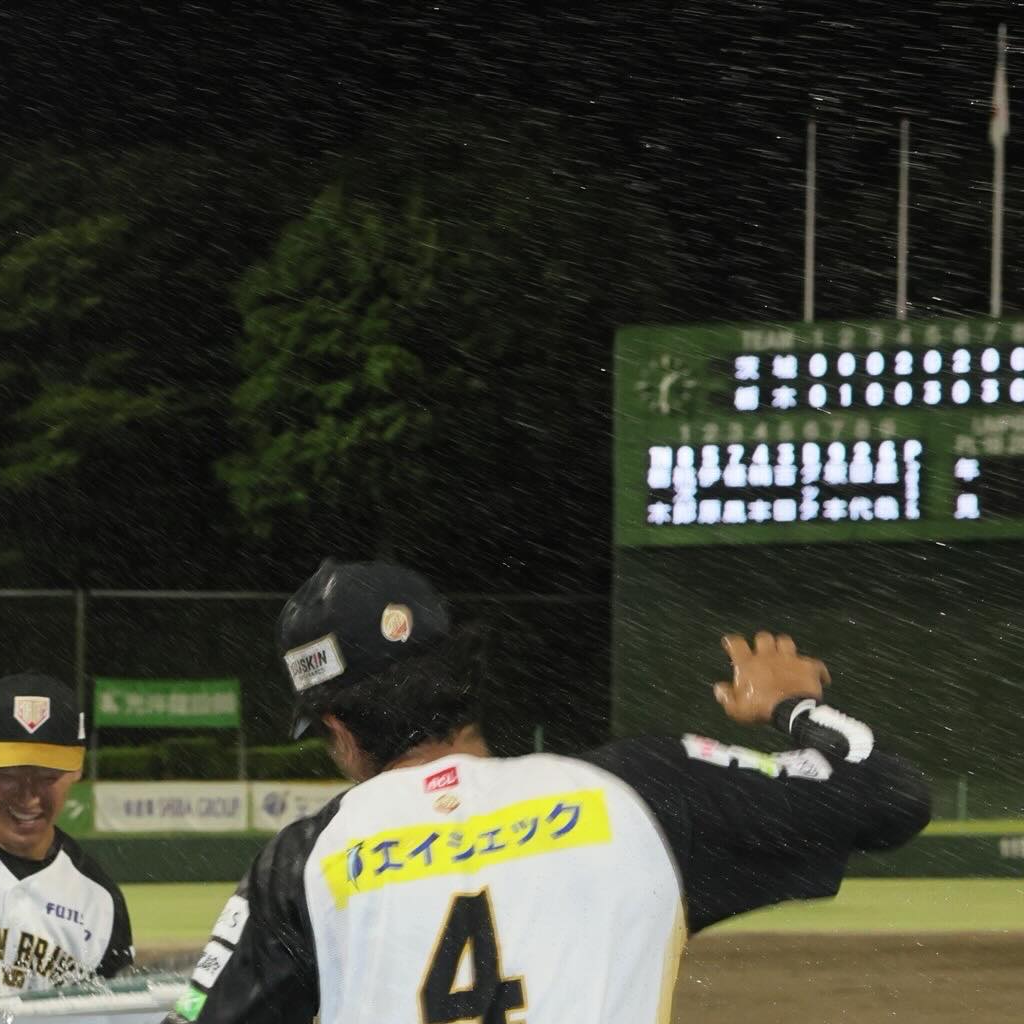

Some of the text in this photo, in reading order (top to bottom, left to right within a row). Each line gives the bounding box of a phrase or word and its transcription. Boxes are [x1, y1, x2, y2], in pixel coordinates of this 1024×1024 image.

[372, 801, 582, 874] エイシェック
